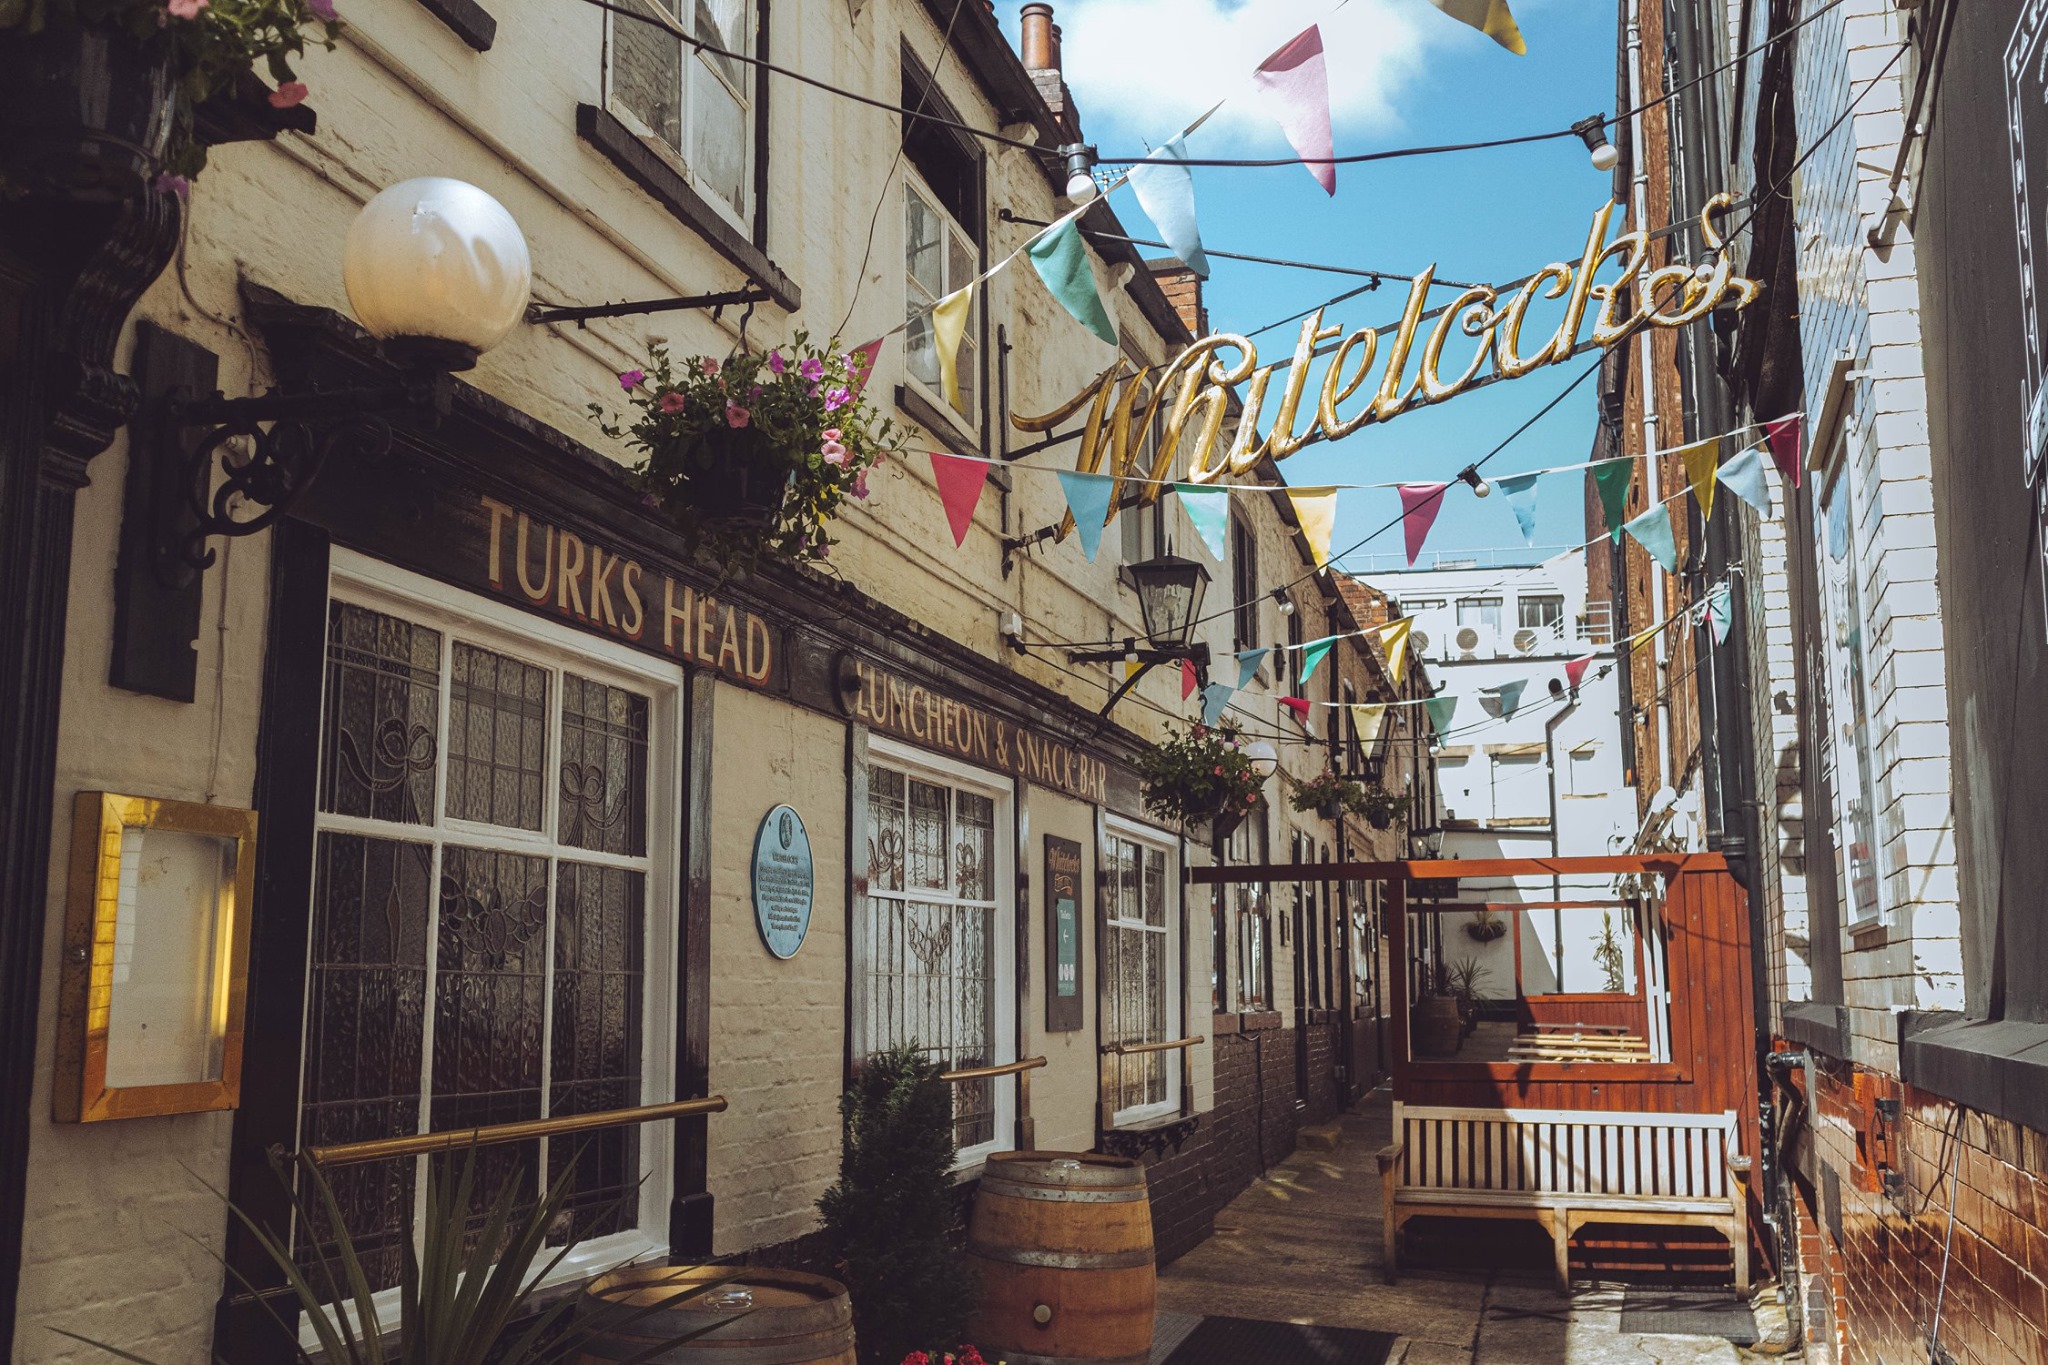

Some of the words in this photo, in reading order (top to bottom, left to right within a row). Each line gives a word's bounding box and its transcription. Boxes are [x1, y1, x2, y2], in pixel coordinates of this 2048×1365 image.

[481, 494, 644, 640] TURKS
[664, 575, 772, 686] HEAD
[855, 660, 989, 760] LUNCHEON
[995, 720, 1010, 768] &
[1016, 727, 1076, 791] SNACK
[1080, 753, 1107, 803] BAR
